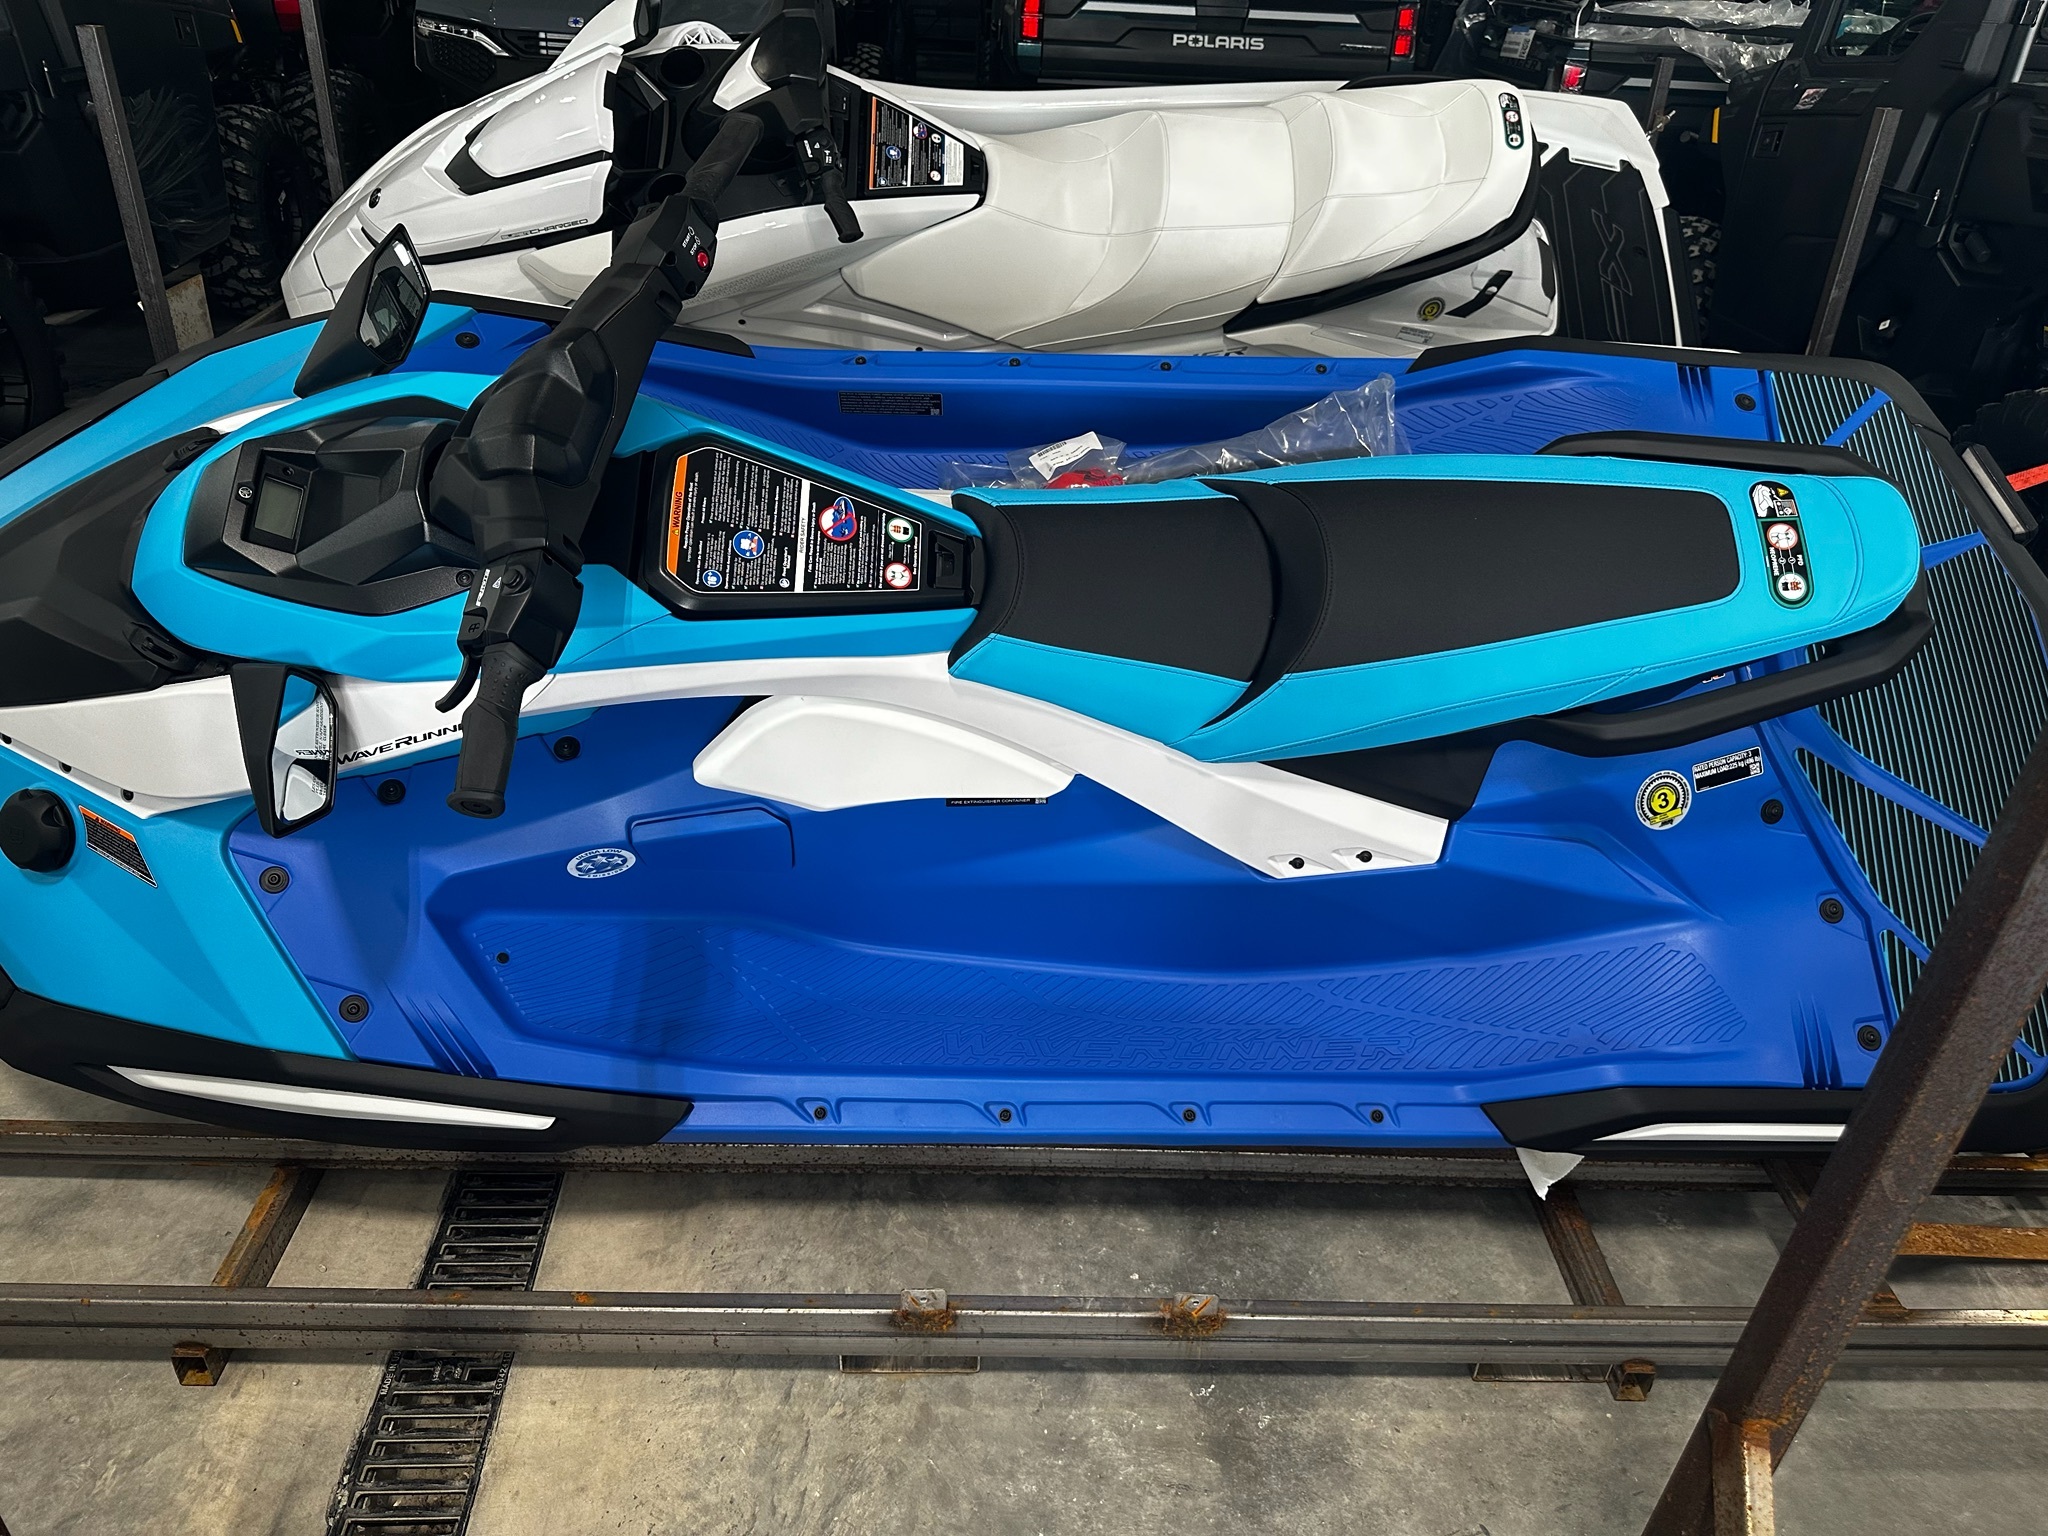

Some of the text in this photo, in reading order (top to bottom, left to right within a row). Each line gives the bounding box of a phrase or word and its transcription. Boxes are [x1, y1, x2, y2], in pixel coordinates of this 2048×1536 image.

[1172, 33, 1265, 51] POLARIS
[682, 233, 692, 248] START
[690, 242, 698, 256] STOP
[672, 491, 682, 527] WARNING
[1768, 546, 1780, 577] NEOPRENE
[1796, 554, 1804, 567] PFD
[1693, 763, 1708, 771] RATED
[1707, 758, 1726, 768] PERSON
[1725, 752, 1748, 763] CAPACITY:
[1694, 768, 1717, 778] MAXIMUM
[1657, 792, 1670, 809] 3
[380, 1372, 396, 1396] MADE
[388, 1363, 397, 1372] IN
